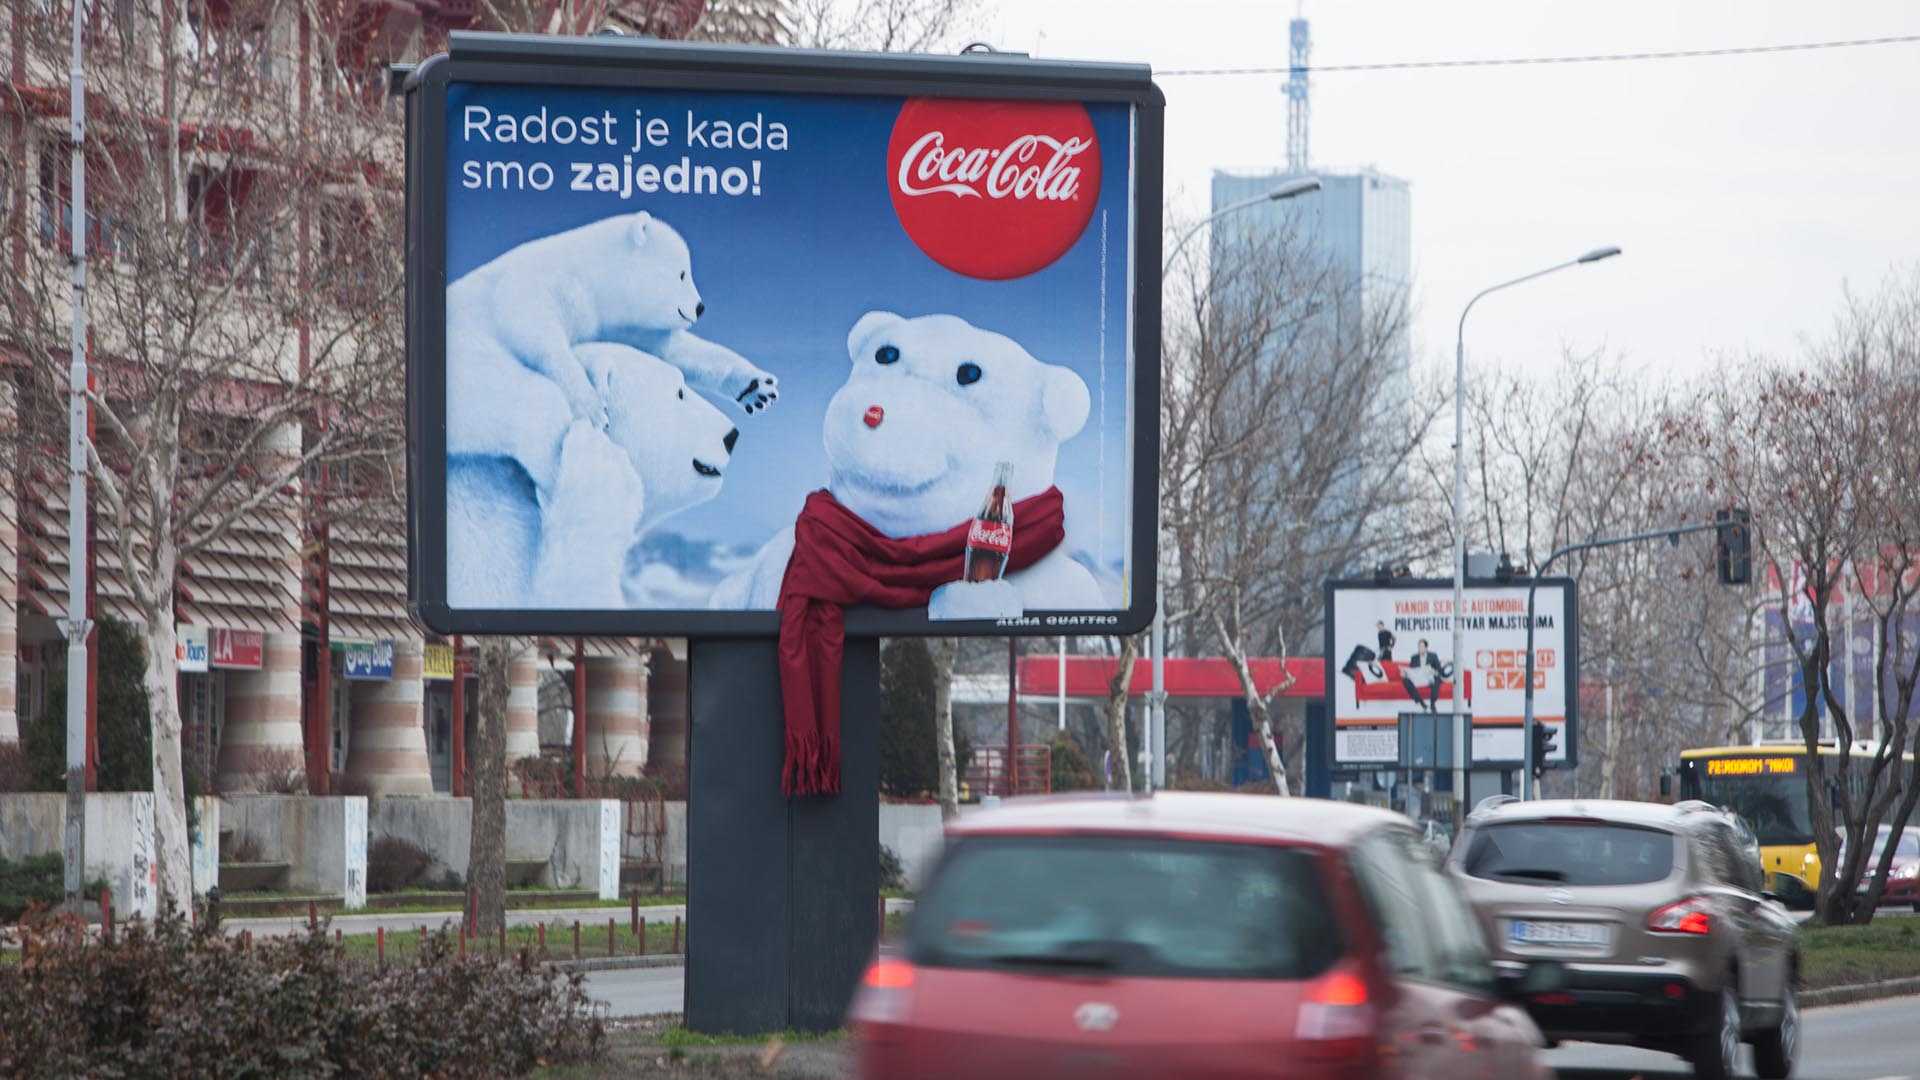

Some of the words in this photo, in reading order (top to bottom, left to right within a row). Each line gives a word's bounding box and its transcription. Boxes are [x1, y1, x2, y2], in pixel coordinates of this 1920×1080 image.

[463, 105, 618, 145] Radost
[631, 109, 670, 152] je
[687, 110, 789, 151] kada
[462, 159, 554, 190] smo
[570, 154, 762, 199] zajedno!
[1434, 599, 1468, 613] SERVS
[1046, 615, 1118, 626] QUATTRO
[1454, 615, 1485, 630] TVAR
[1489, 614, 1554, 629] MAJSTOIMA
